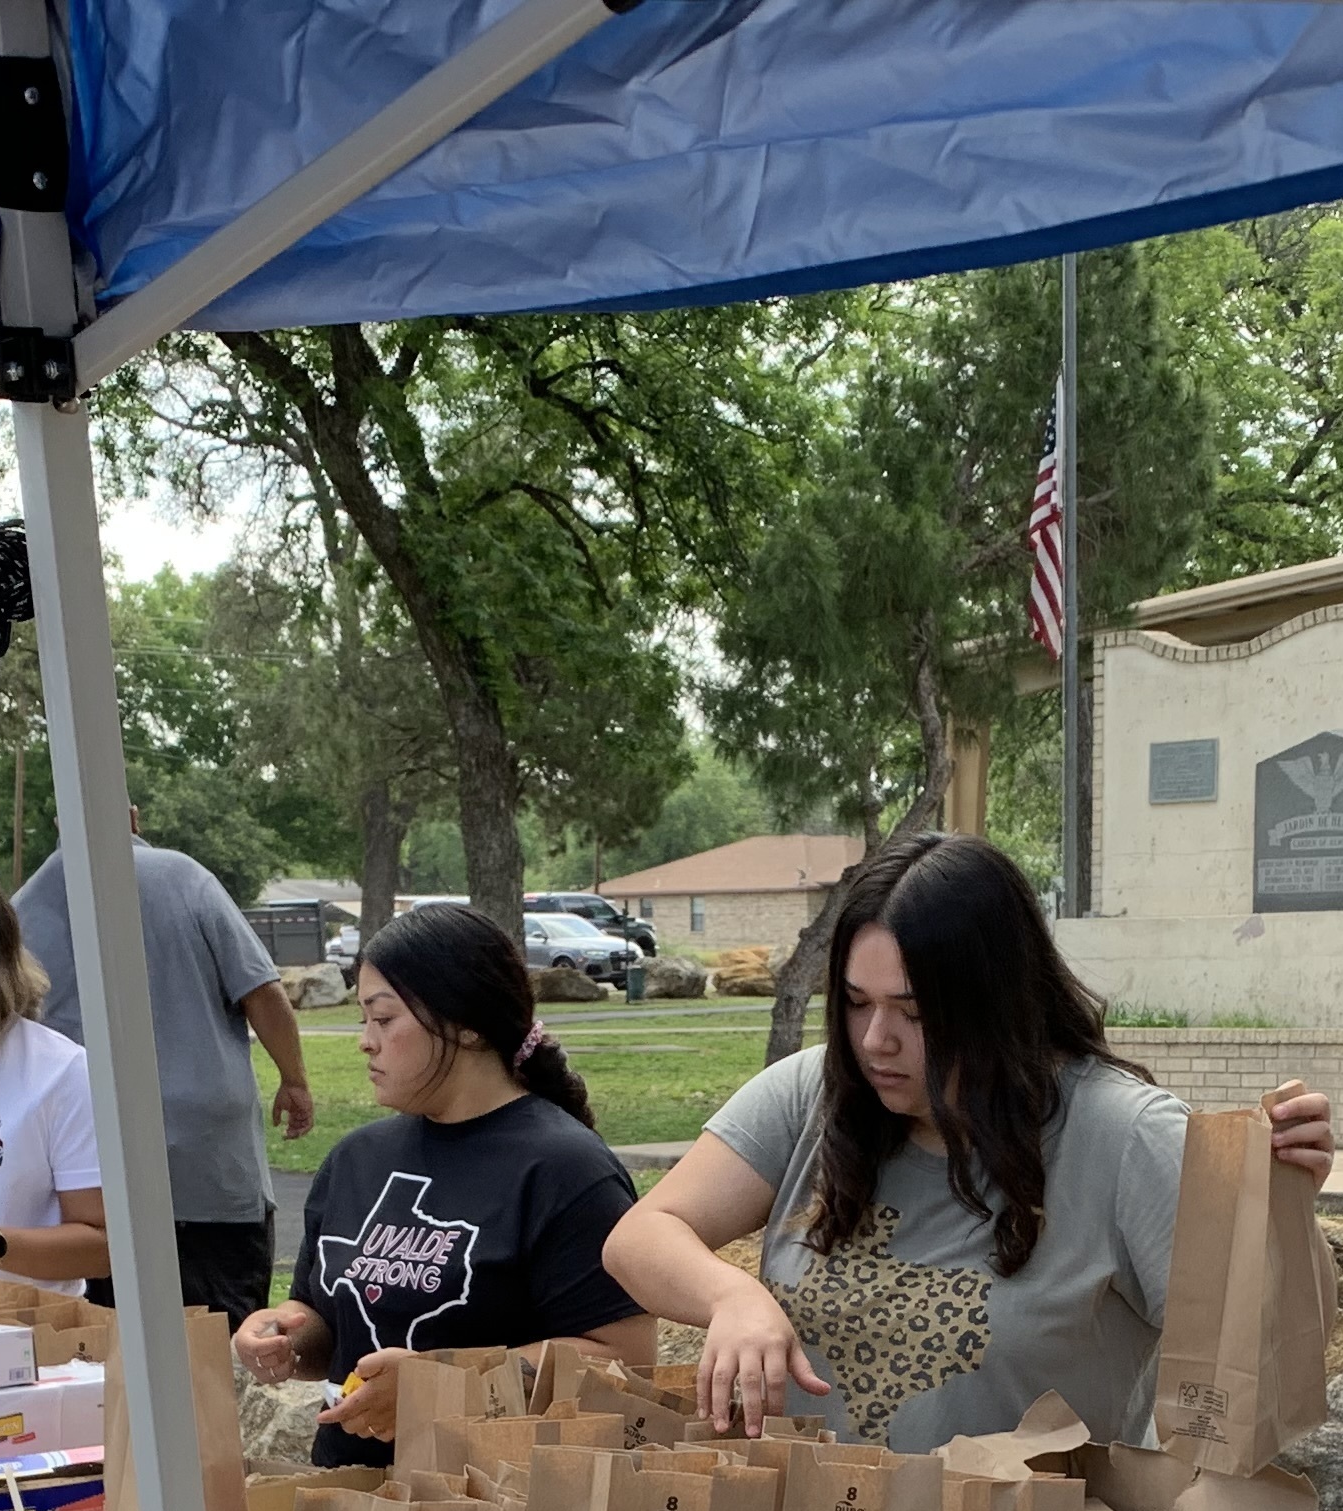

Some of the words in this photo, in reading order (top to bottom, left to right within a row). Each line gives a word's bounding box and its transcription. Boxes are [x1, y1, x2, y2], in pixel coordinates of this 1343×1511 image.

[1318, 817, 1328, 827] DE
[363, 1223, 461, 1266] UVALDE
[344, 1257, 442, 1293] STRONG
[846, 1486, 858, 1501] 8
[666, 1496, 679, 1511] 8
